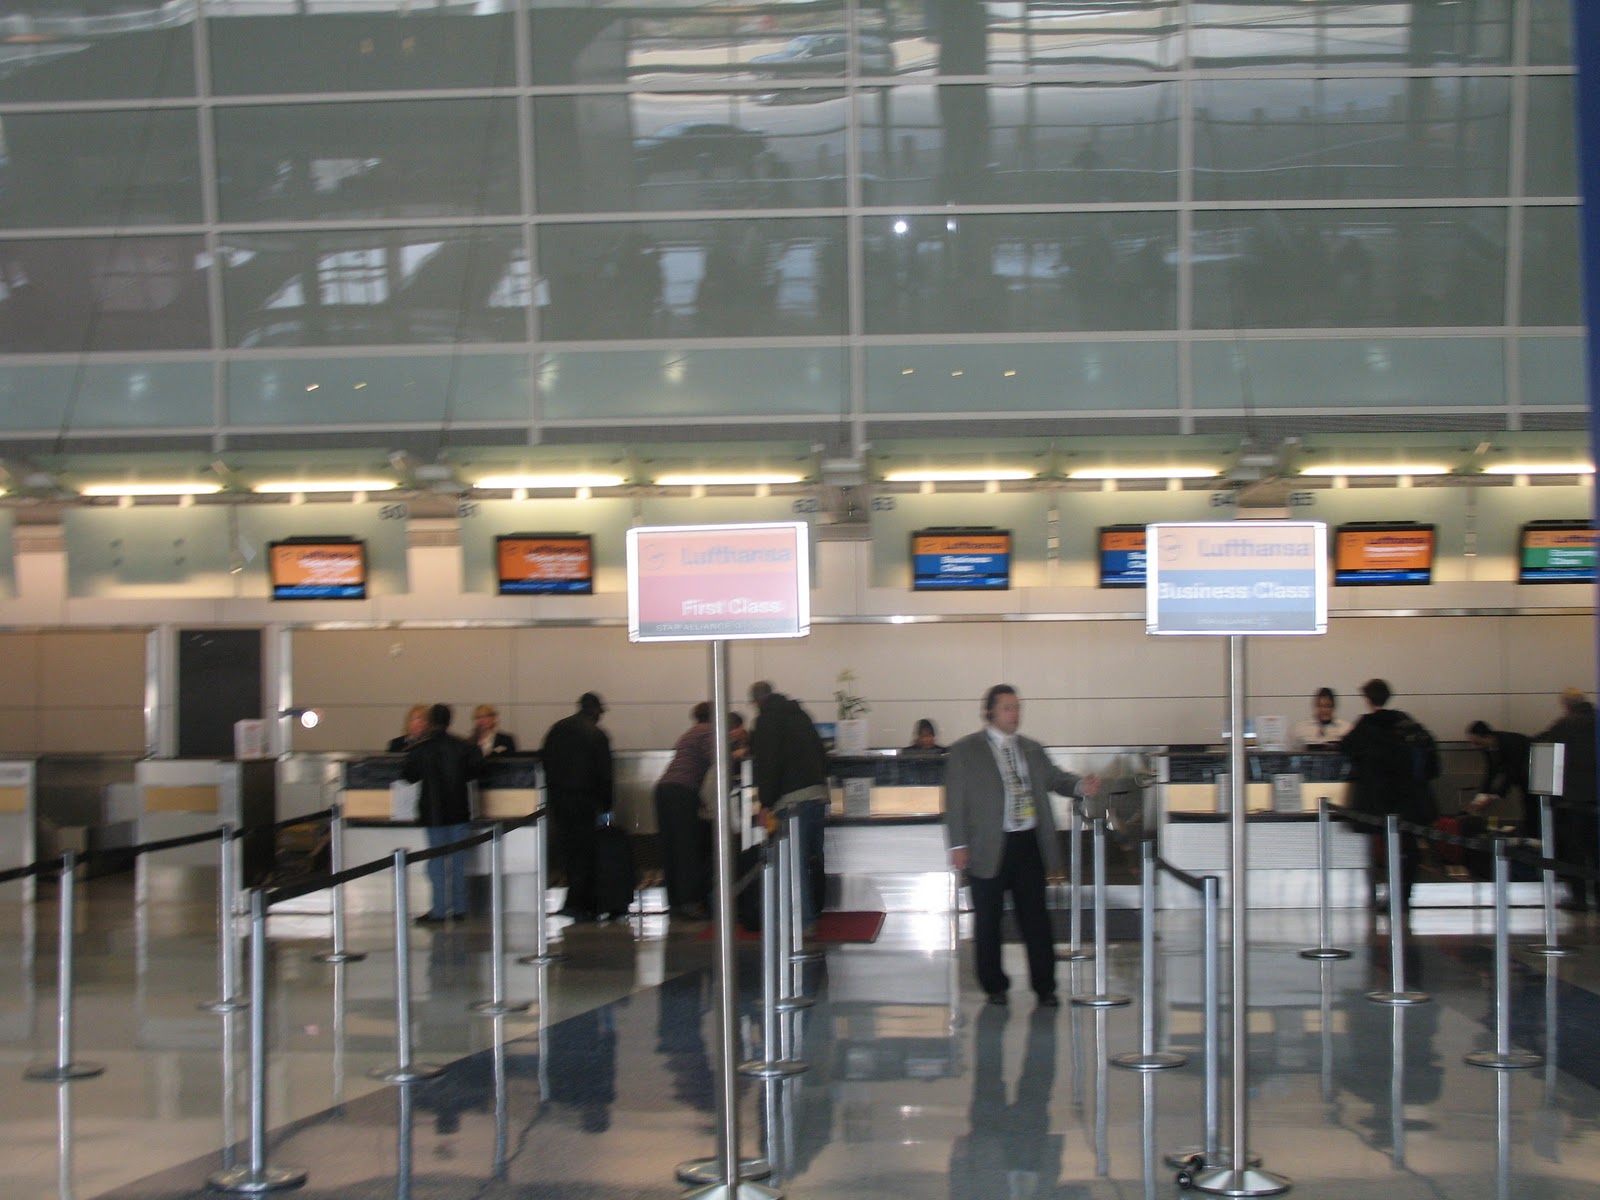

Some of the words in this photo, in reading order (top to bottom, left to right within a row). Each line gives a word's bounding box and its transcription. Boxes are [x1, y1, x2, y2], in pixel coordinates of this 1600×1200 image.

[680, 543, 792, 565] Lufthansa
[1197, 539, 1311, 558] Lufthansa
[1158, 582, 1249, 600] Business
[1253, 581, 1314, 600] Class
[681, 599, 723, 616] First
[728, 597, 784, 615] Class
[655, 623, 681, 632] STAR
